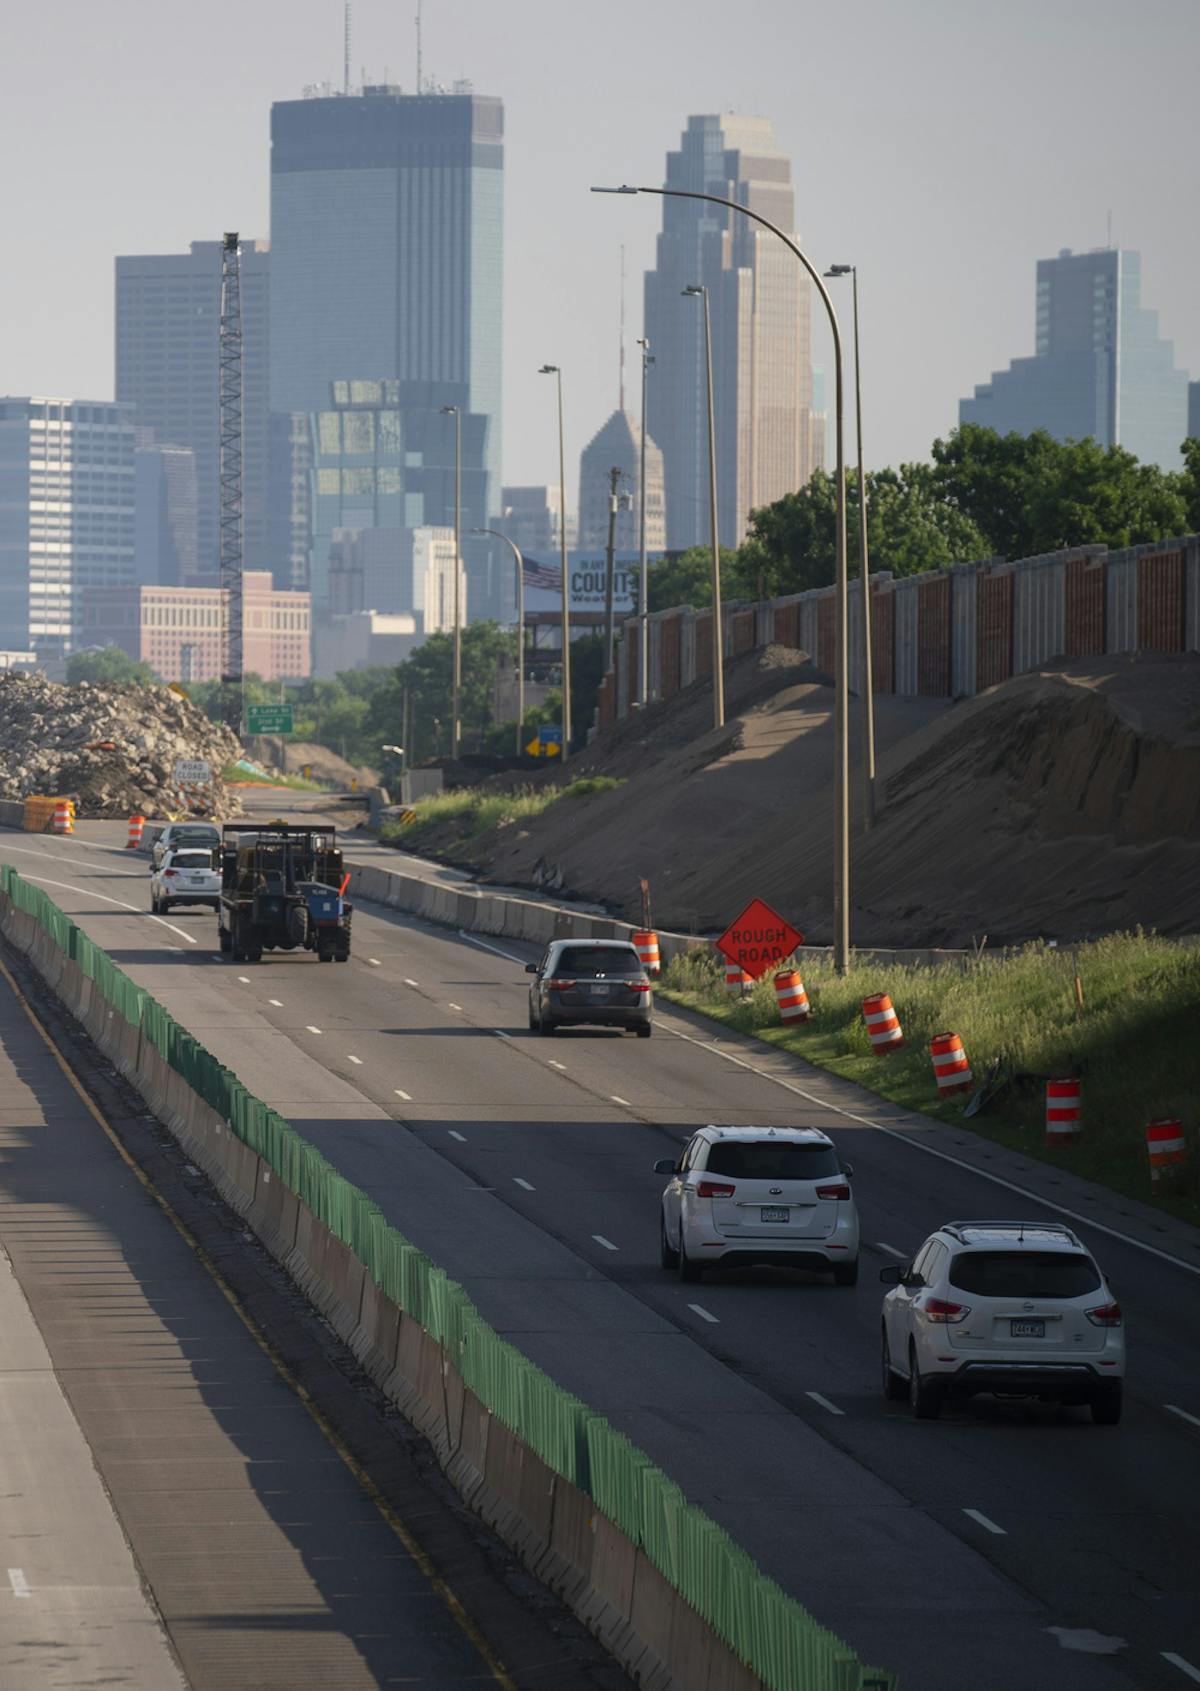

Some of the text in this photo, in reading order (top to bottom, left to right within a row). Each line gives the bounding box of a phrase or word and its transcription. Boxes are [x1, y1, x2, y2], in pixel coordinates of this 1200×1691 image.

[571, 572, 629, 593] COUT
[182, 763, 203, 771] ROAD
[176, 771, 208, 779] CLOSED
[732, 927, 786, 945] ROUGH
[738, 947, 782, 962] ROAD
